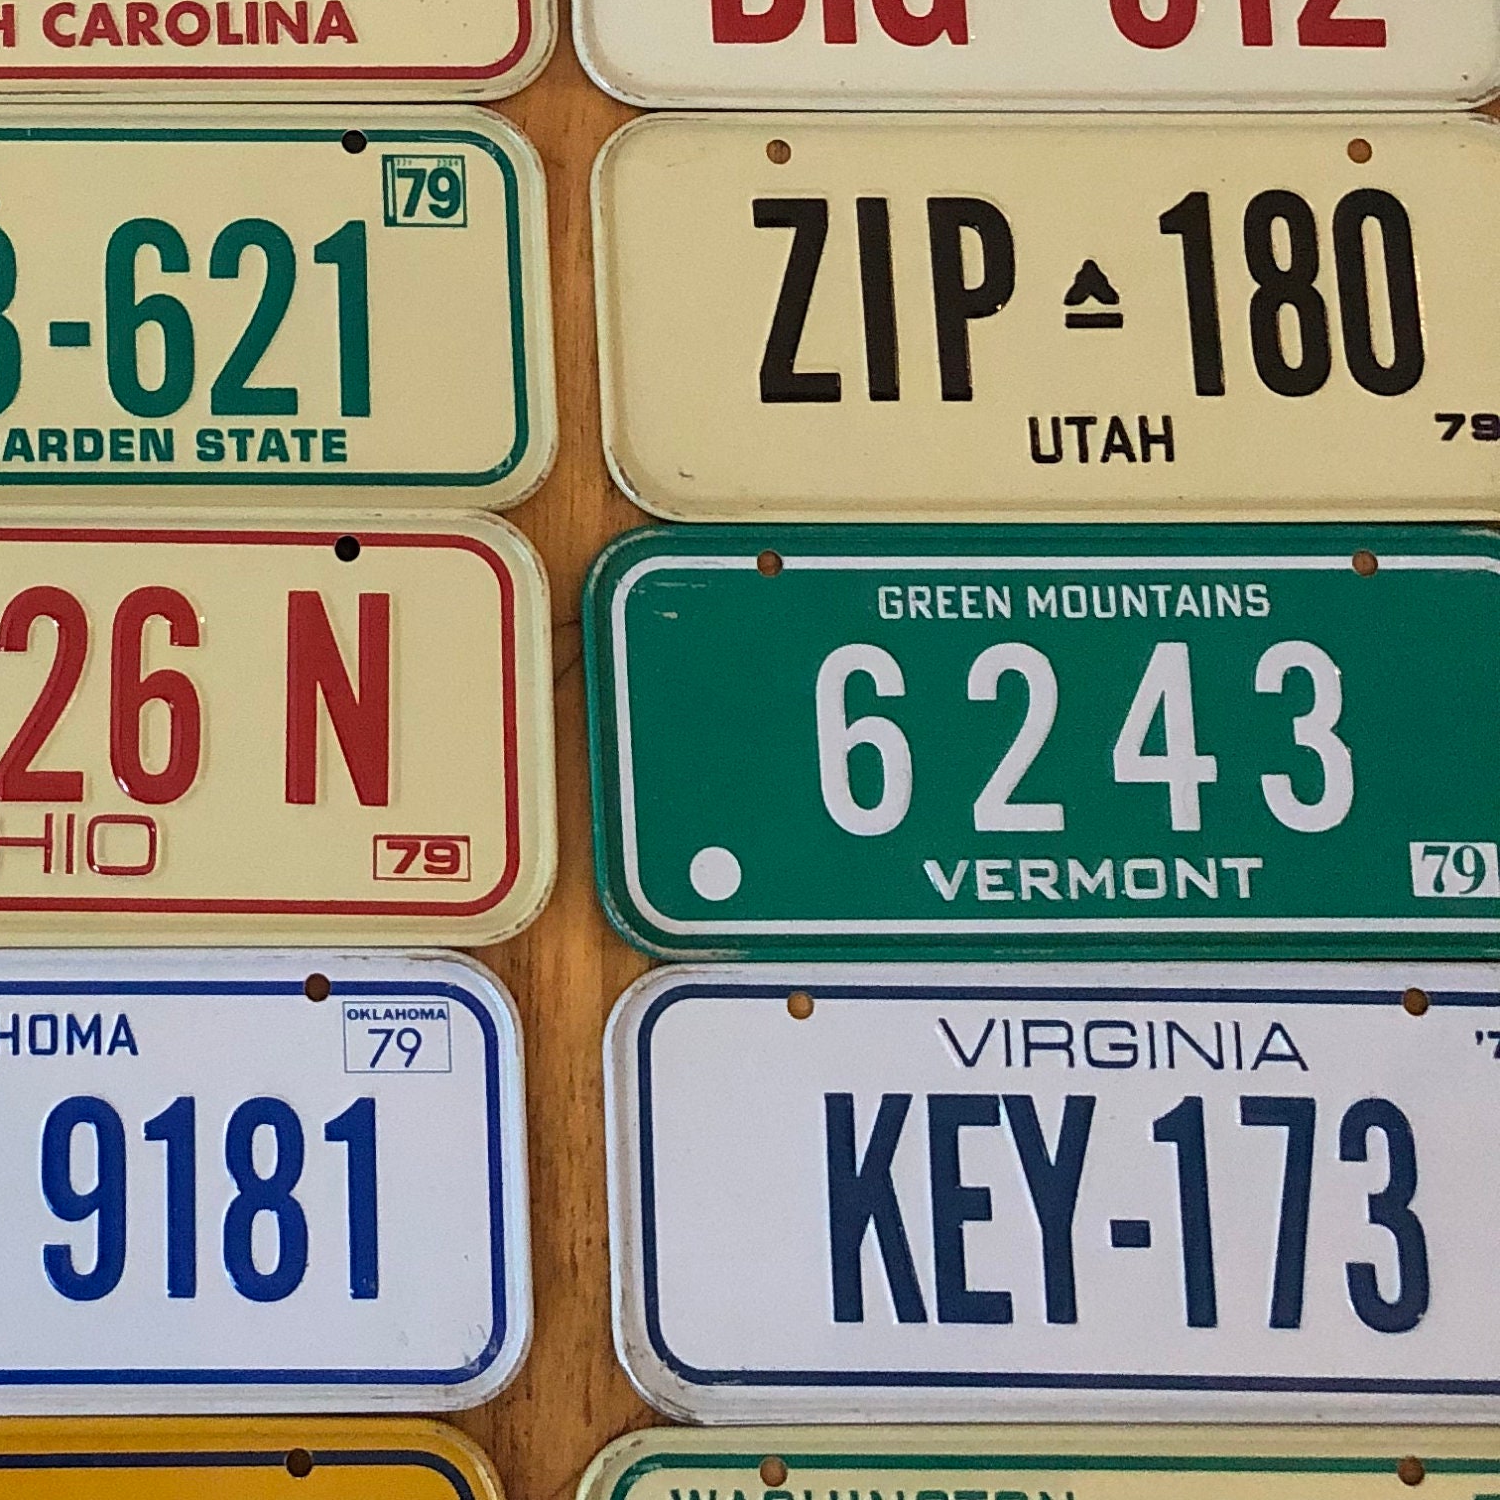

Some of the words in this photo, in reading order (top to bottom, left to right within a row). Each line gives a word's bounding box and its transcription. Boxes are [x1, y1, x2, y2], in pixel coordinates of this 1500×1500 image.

[43, 0, 358, 48] CAROLINA
[397, 167, 460, 218] 79
[752, 197, 1015, 403] ZIP
[1159, 188, 1425, 397] 180
[196, 428, 347, 462] STATE
[1029, 415, 1174, 463] UTAH
[1435, 413, 1500, 441] 79
[879, 586, 1011, 619] GREEN
[1028, 584, 1270, 618] MOUNTAINS
[285, 590, 390, 807] N
[386, 841, 461, 874] 79
[923, 858, 1262, 900] VERMONT
[1422, 844, 1485, 894] 79
[347, 1008, 448, 1021] OKLAHOMA
[364, 1028, 422, 1073] 79
[939, 1018, 1308, 1071] VIRGINIA
[824, 1093, 1430, 1334] KEY-173
